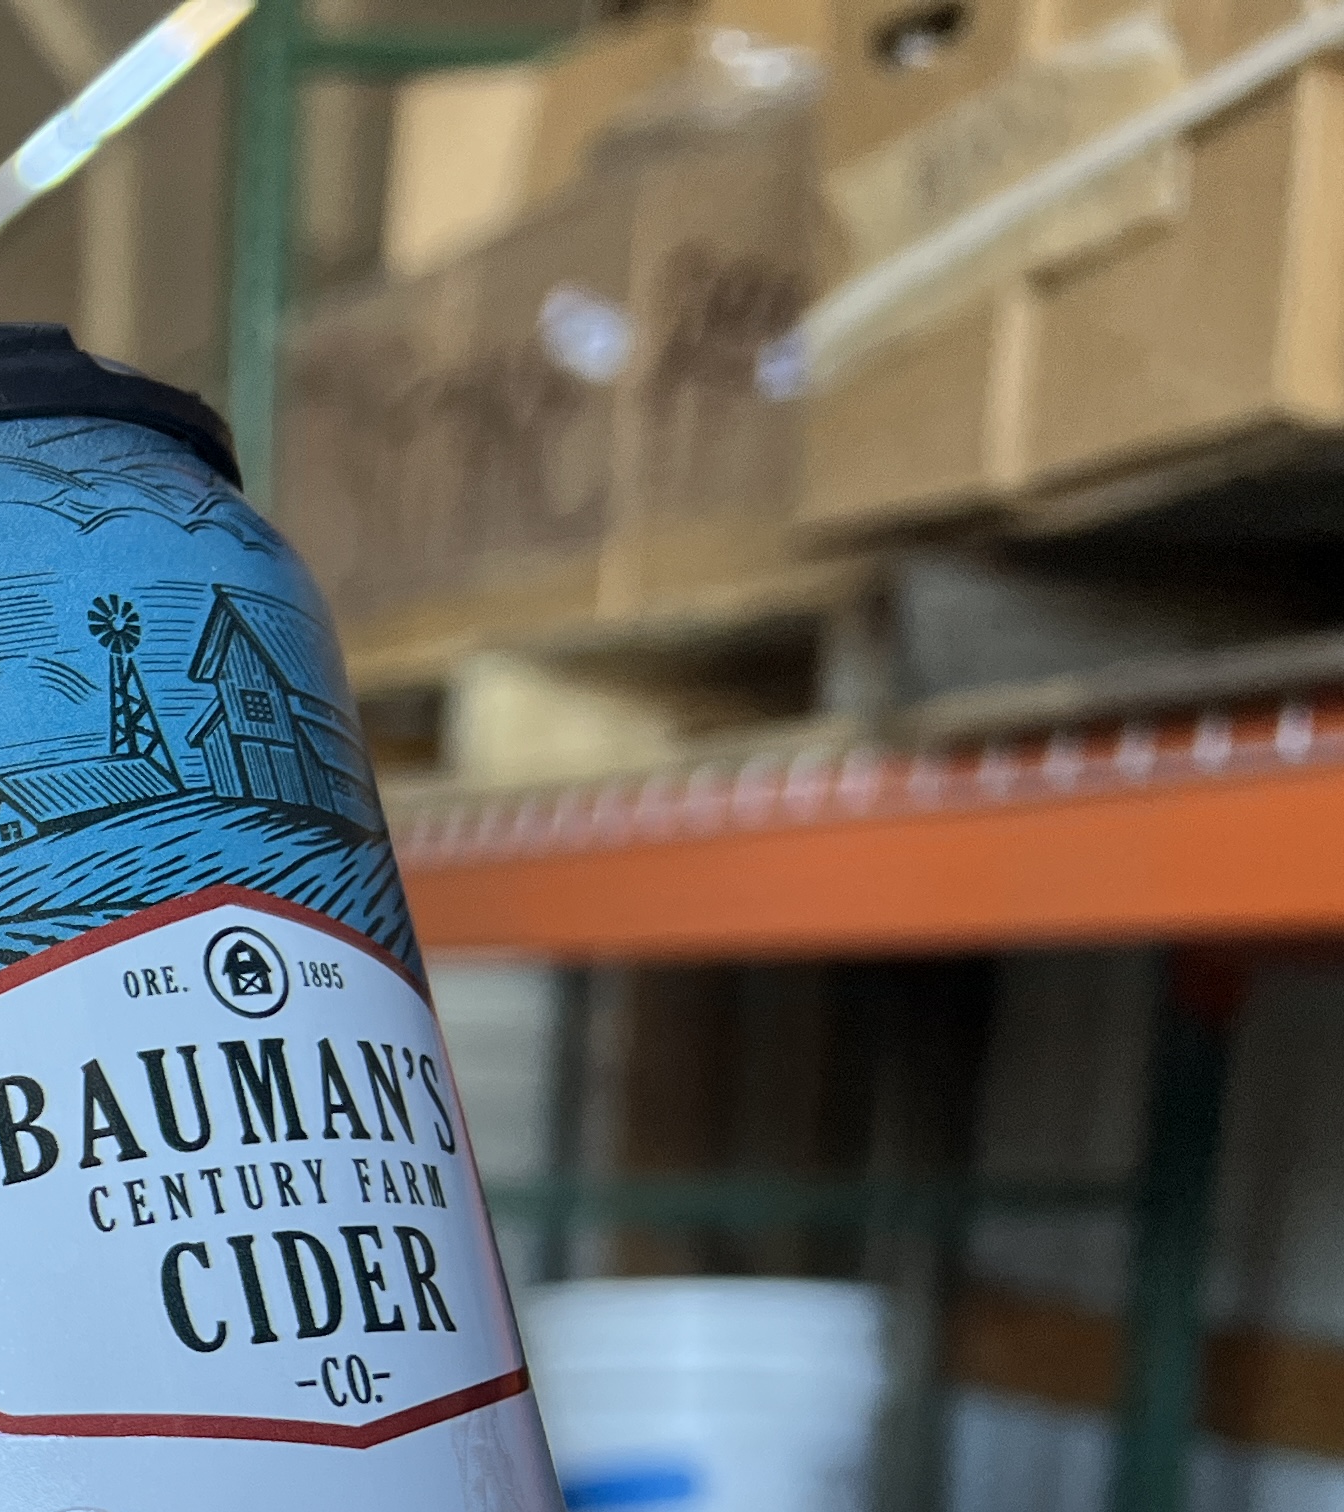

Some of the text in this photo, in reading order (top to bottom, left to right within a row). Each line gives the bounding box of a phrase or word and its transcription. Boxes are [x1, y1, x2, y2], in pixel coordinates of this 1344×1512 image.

[123, 960, 345, 1000] ORE. 1895
[88, 1157, 449, 1233] CENTURY FARM
[160, 1223, 458, 1355] CIDER
